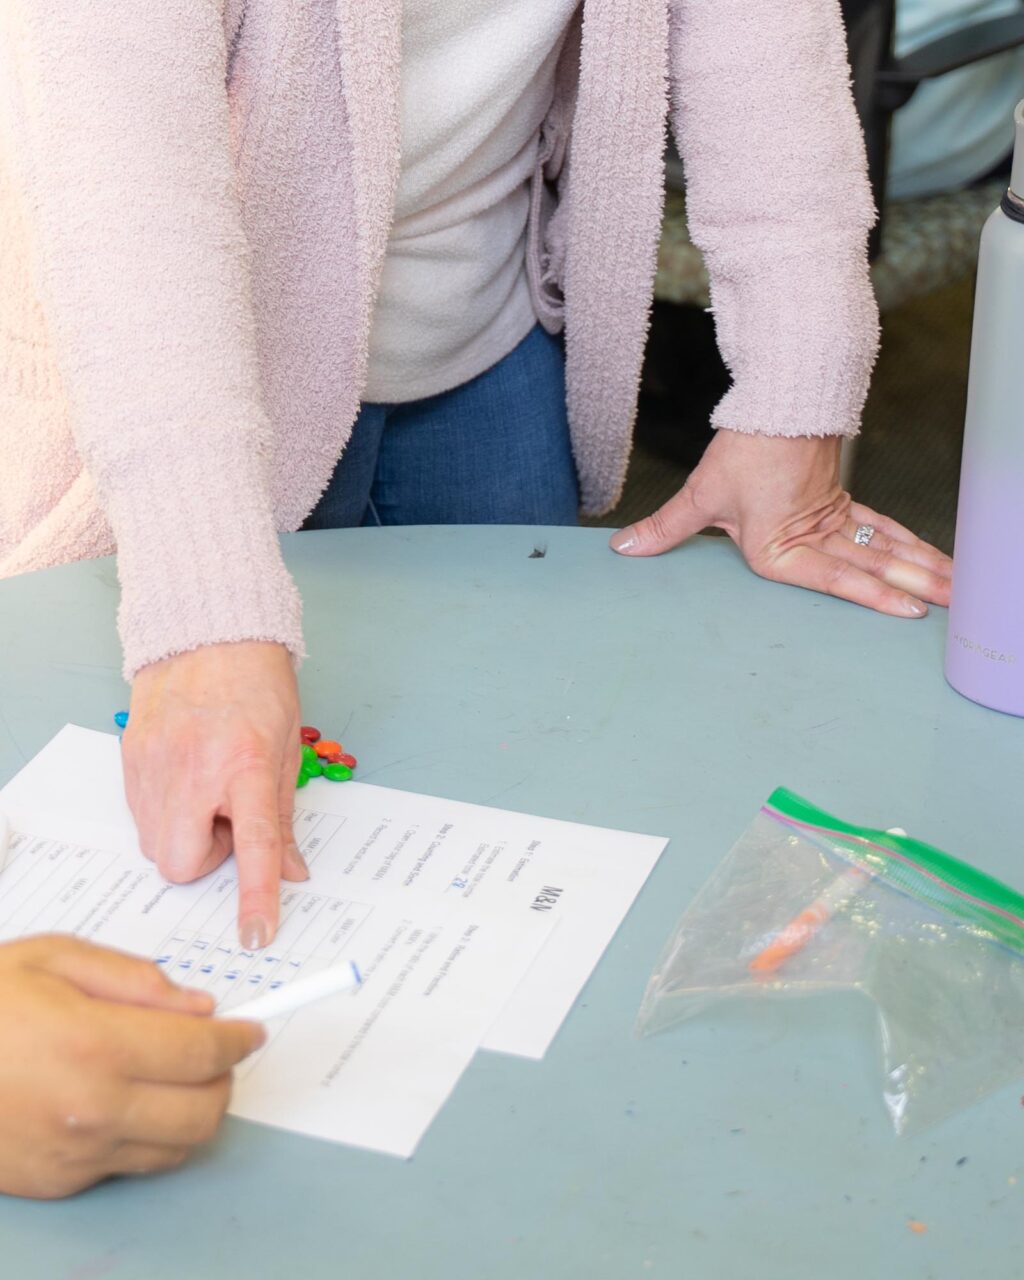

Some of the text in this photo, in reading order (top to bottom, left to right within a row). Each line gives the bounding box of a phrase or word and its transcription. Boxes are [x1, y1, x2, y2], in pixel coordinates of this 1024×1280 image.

[417, 841, 440, 861] Counting
[412, 862, 423, 871] and
[508, 858, 529, 881] Estimation
